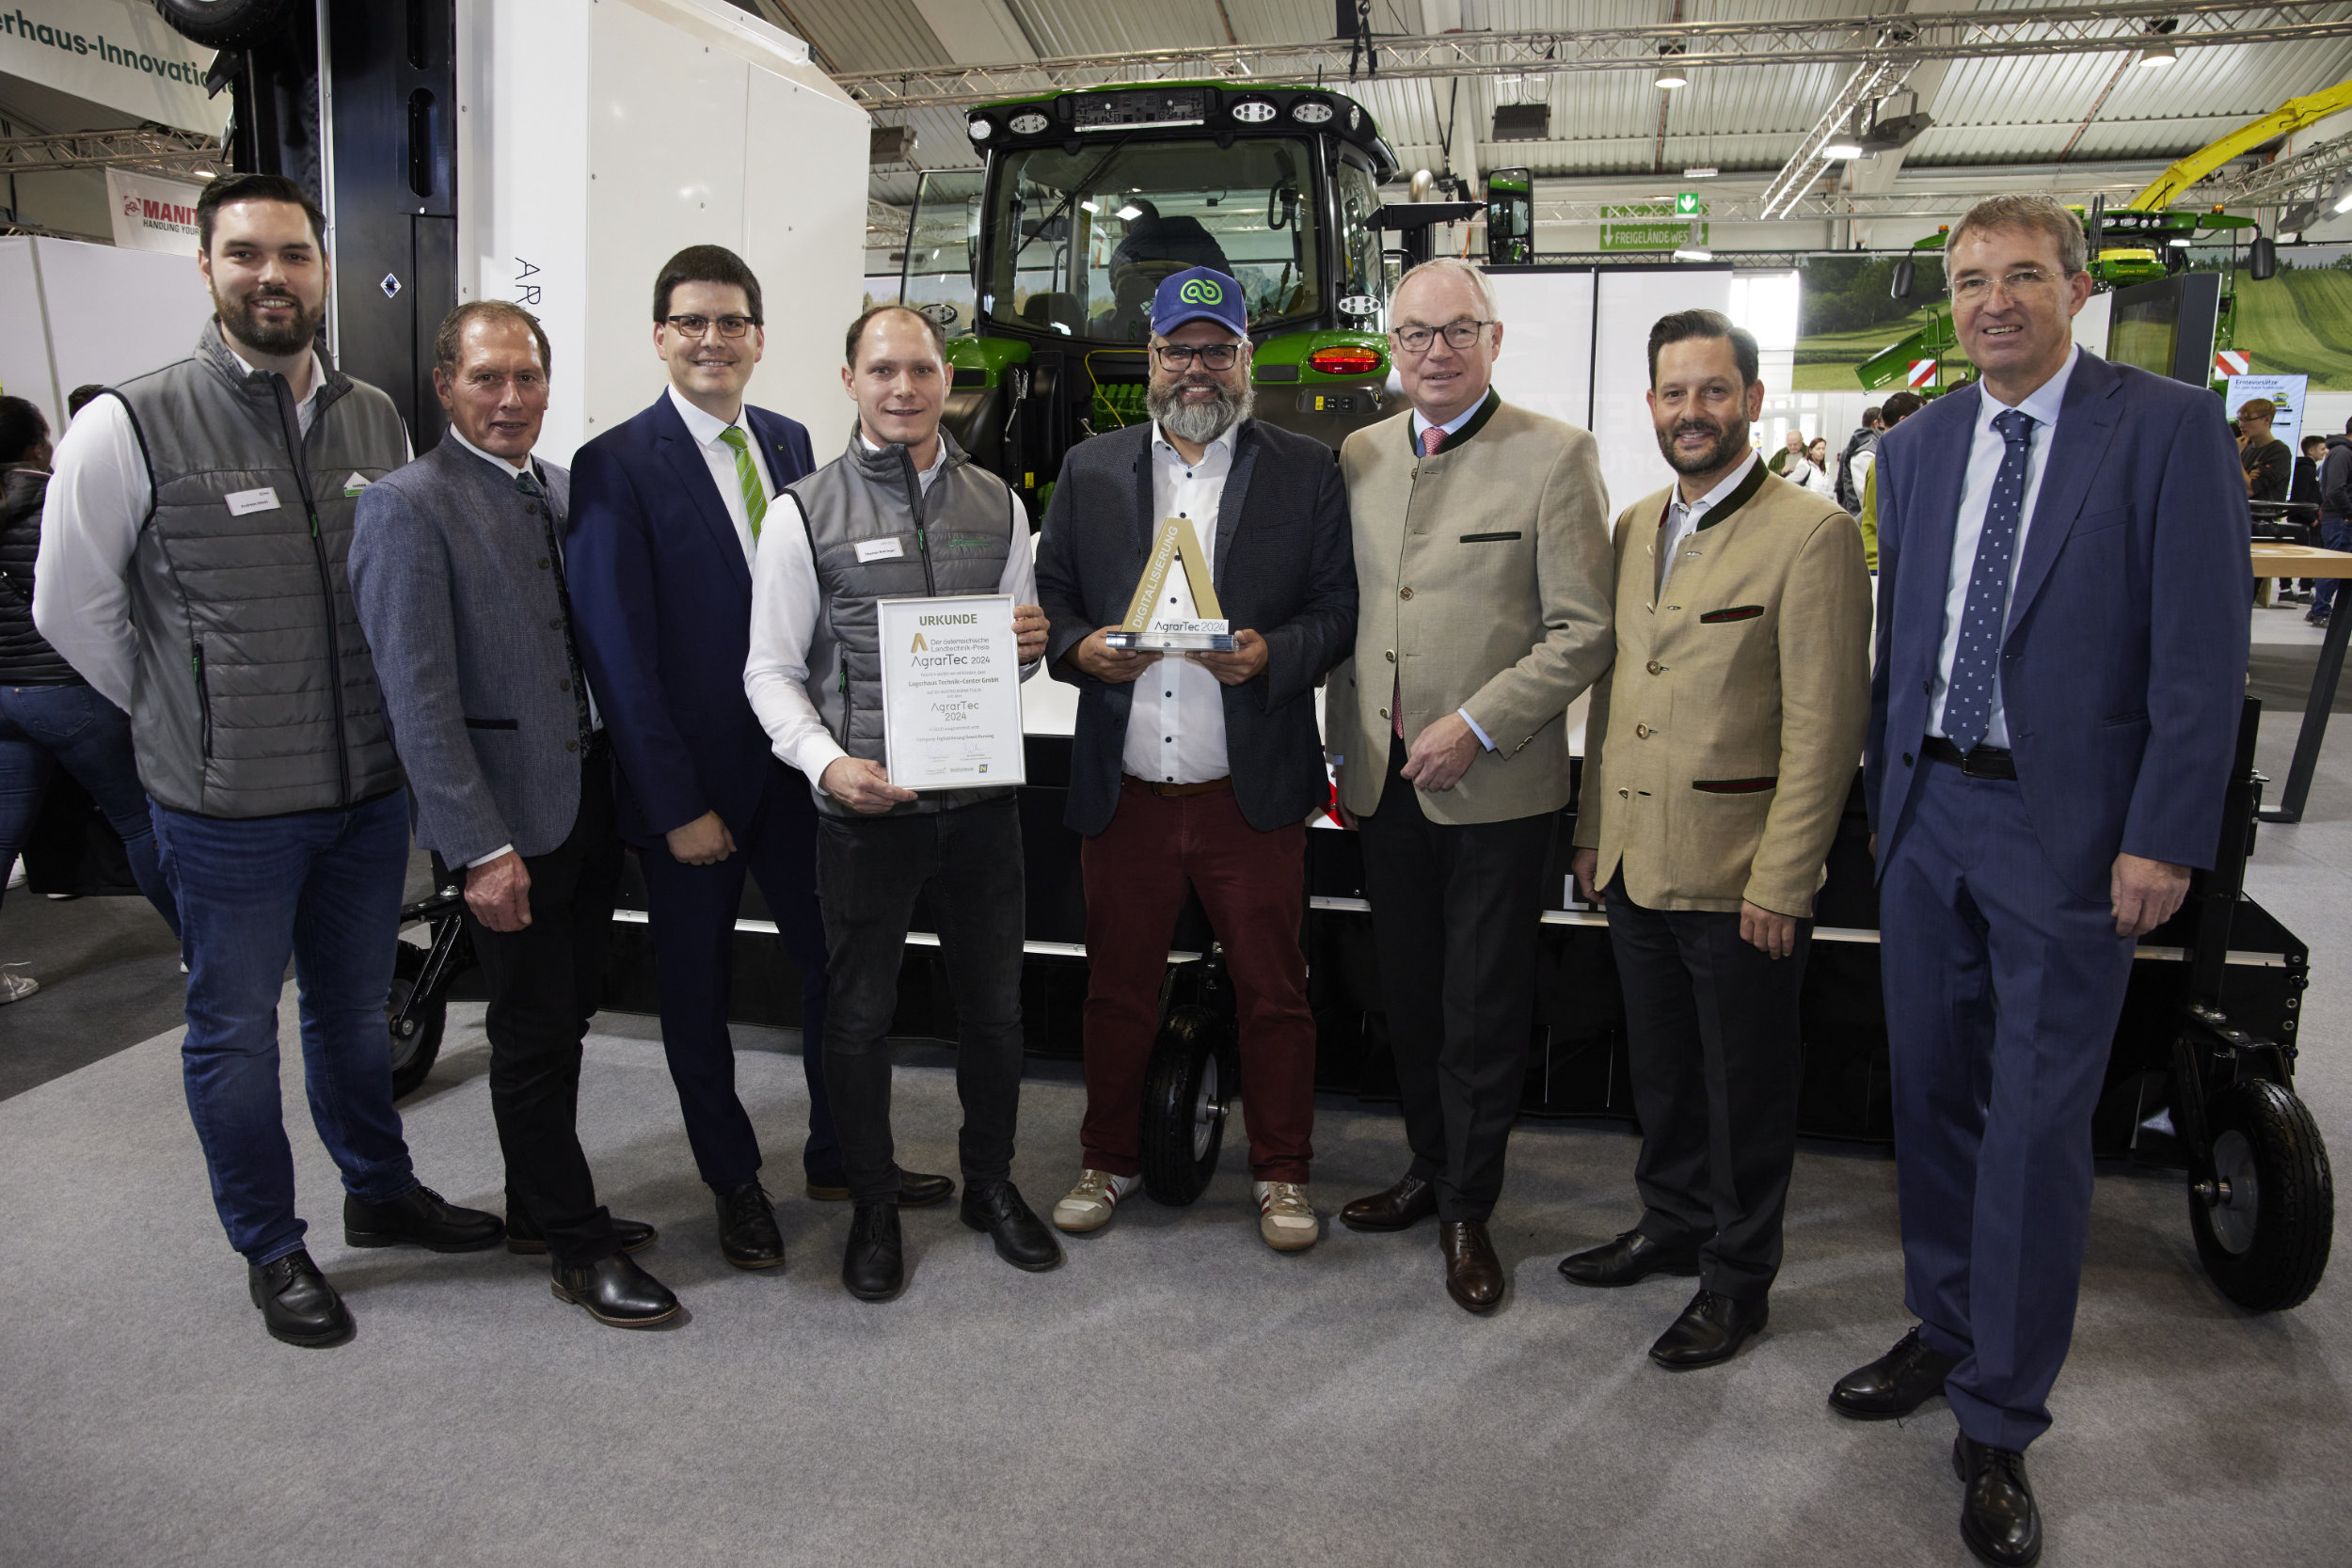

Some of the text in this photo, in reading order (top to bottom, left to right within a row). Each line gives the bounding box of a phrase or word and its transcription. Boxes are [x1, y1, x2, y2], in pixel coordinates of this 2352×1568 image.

[143, 219, 180, 233] HANDLING
[1615, 229, 1691, 245] FREIGELÄNDE WES
[1132, 526, 1179, 629] DIGITALISIERUNG
[919, 613, 978, 626] URKUNDE
[1154, 621, 1226, 633] AgrarTec 2024
[911, 654, 991, 670] AgrarTec 2024
[930, 701, 979, 714] AgrarTec
[945, 712, 967, 721] 2024
